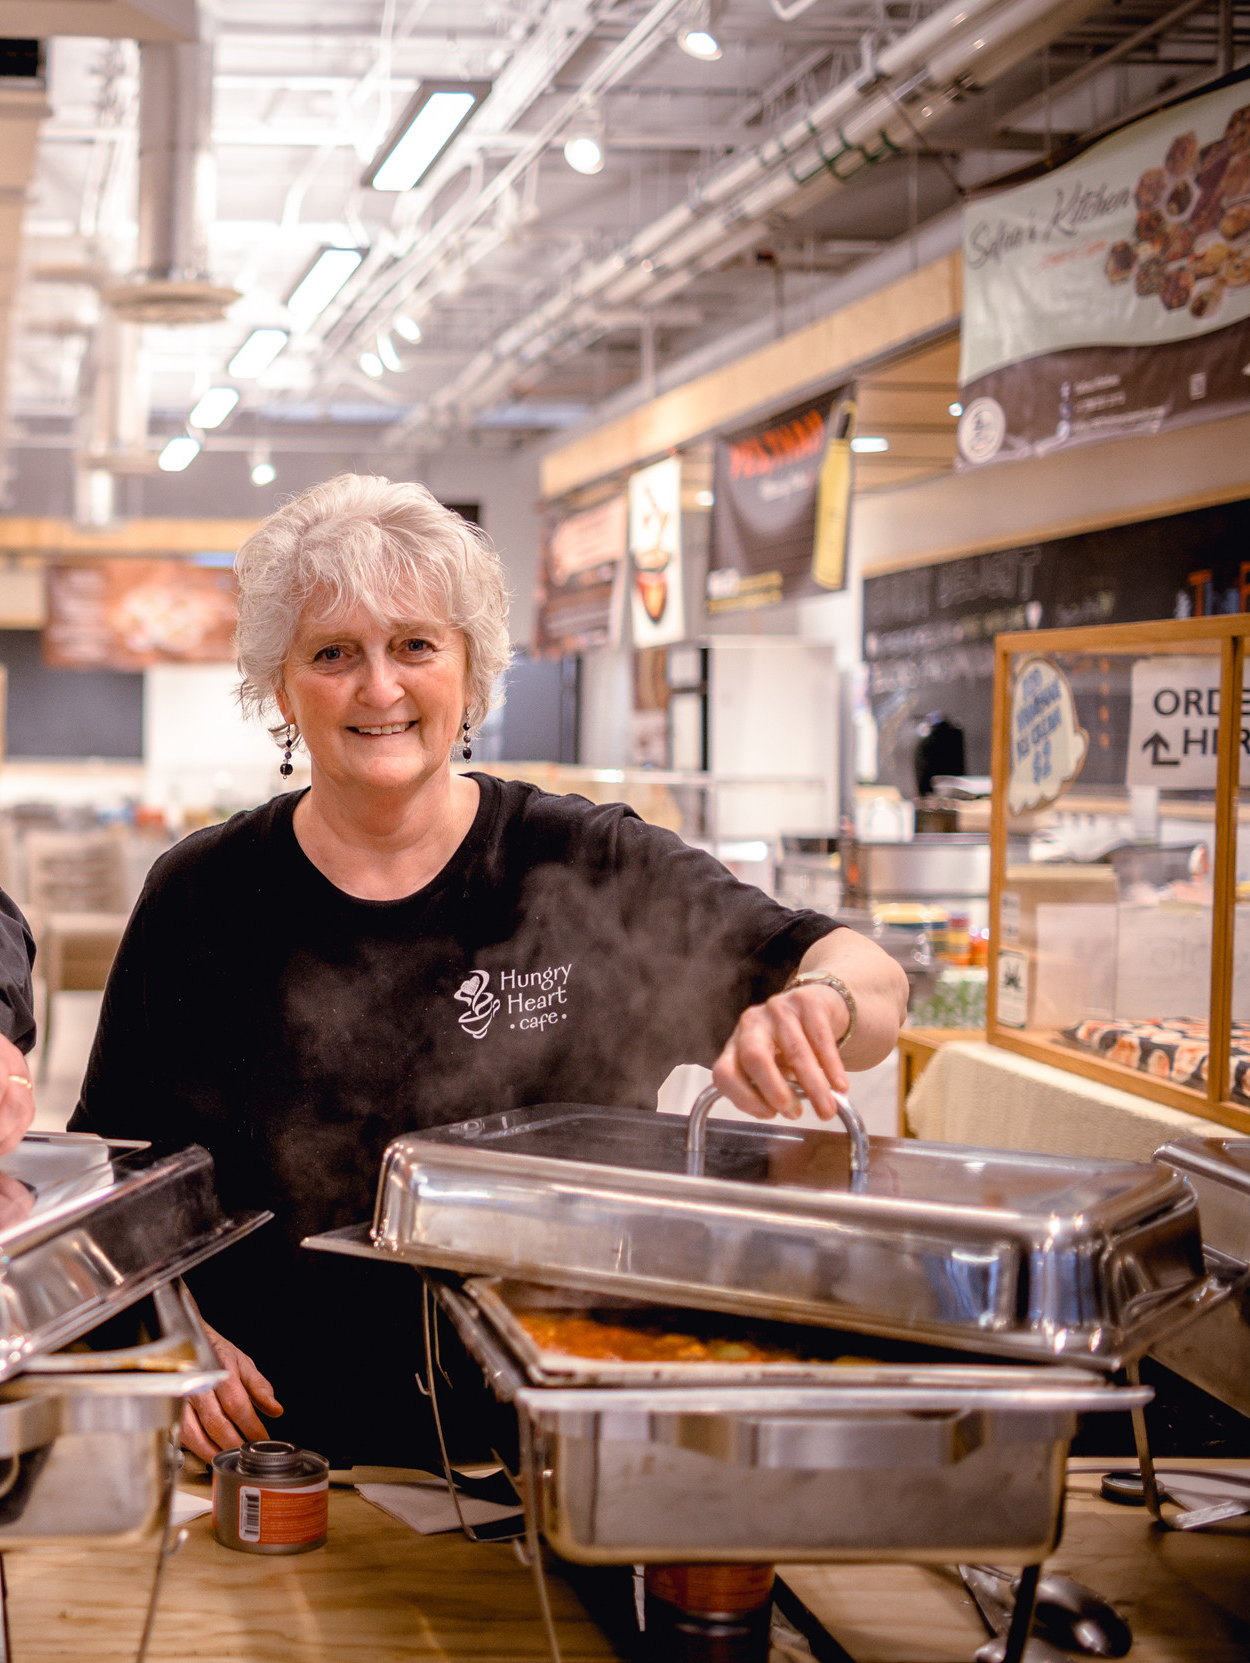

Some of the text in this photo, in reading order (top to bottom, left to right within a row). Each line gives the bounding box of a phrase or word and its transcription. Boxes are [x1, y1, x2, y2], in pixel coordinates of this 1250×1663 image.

[500, 963, 572, 991] Hungry
[507, 986, 567, 1014] Heart
[519, 1012, 559, 1032] cafe
